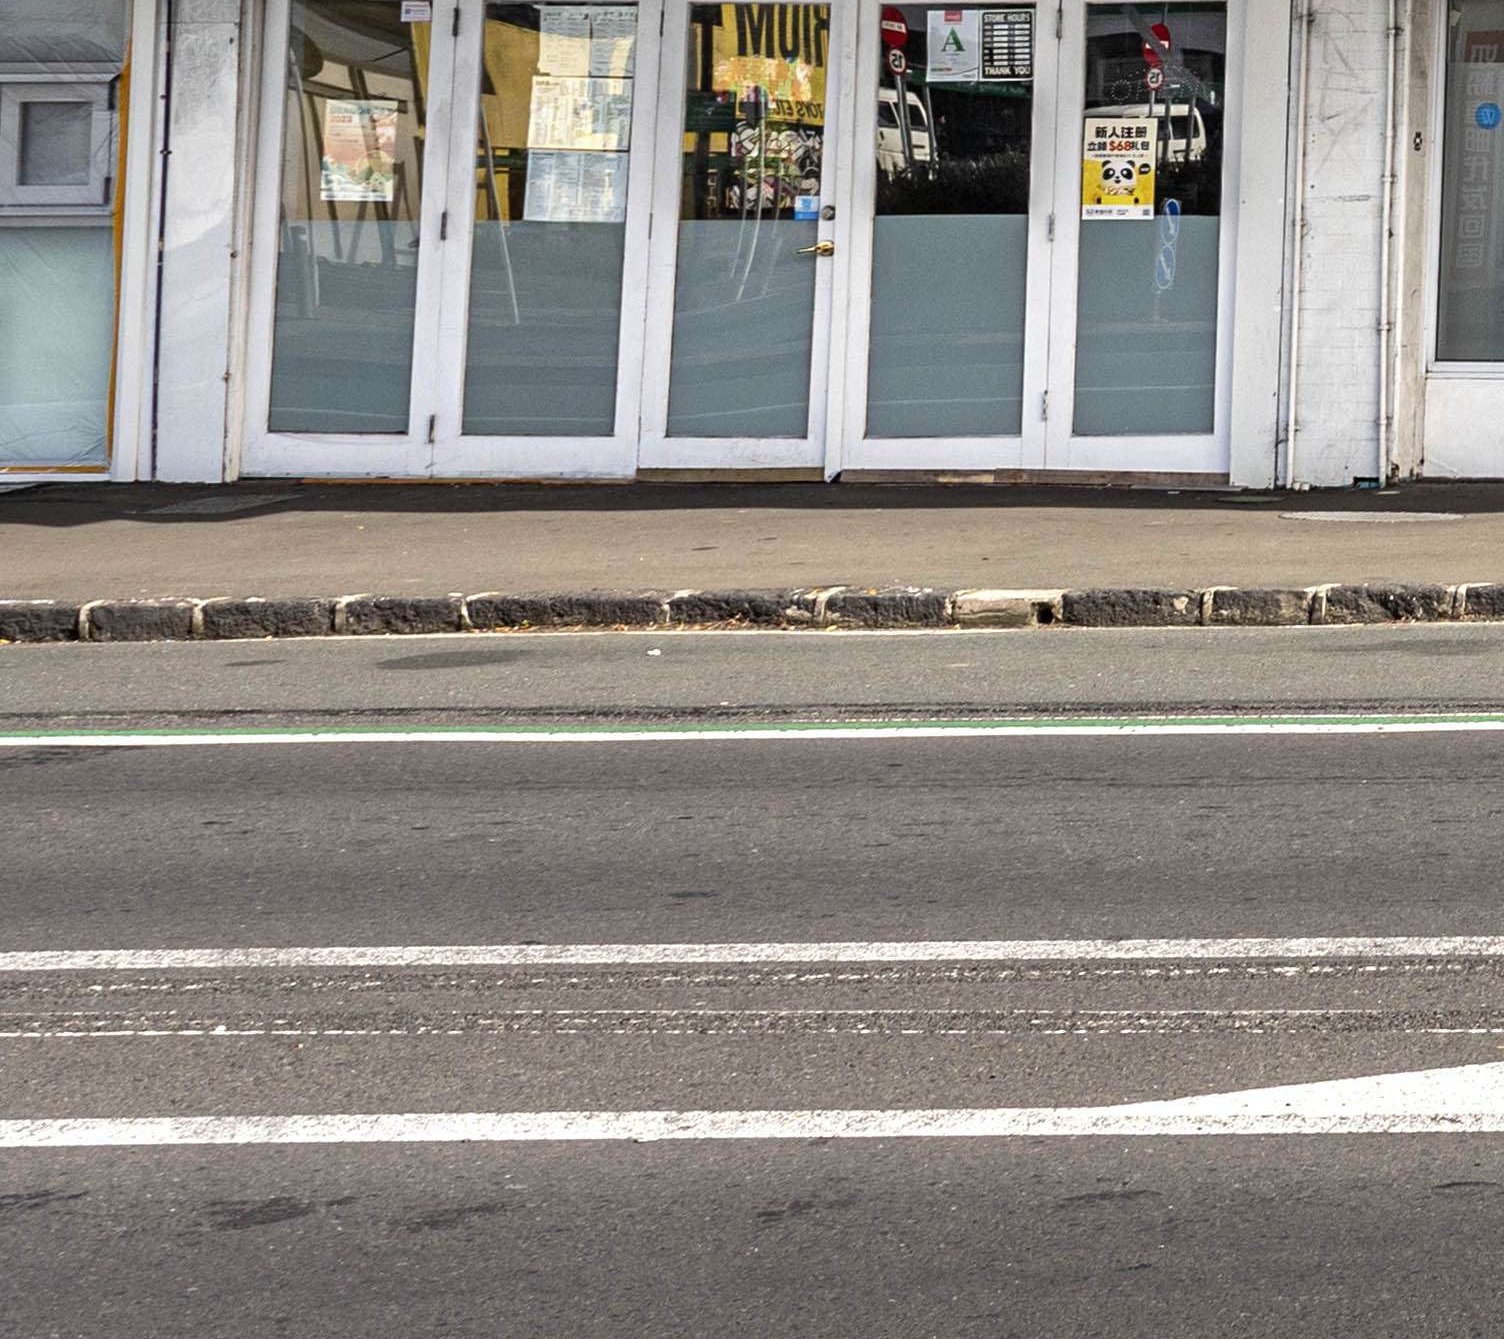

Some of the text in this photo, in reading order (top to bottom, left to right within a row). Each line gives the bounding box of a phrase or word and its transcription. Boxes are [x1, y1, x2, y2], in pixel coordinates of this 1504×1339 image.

[984, 14, 1030, 22] STORE HOURS
[941, 26, 966, 52] A
[985, 66, 1030, 75] THANK YOU
